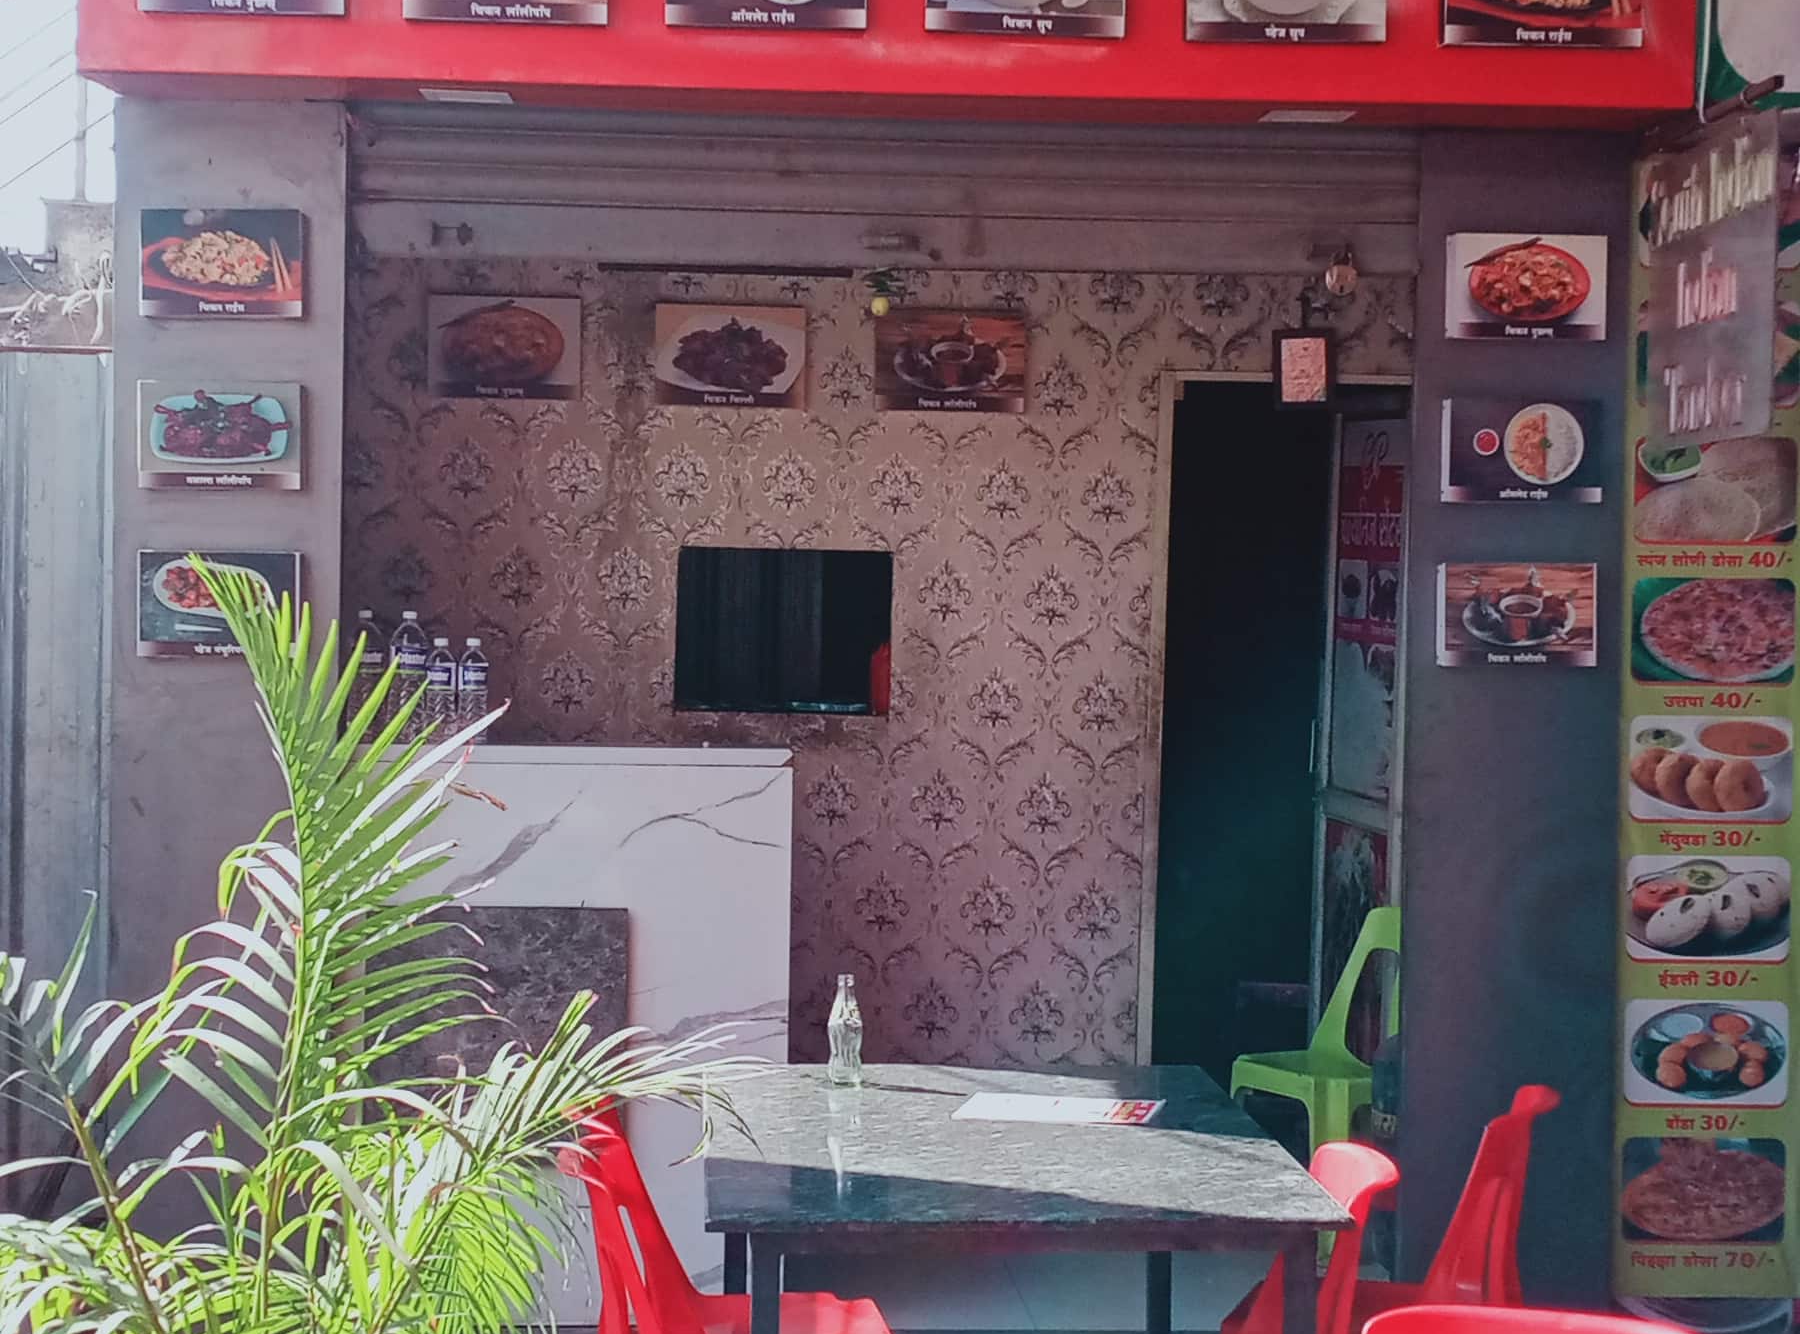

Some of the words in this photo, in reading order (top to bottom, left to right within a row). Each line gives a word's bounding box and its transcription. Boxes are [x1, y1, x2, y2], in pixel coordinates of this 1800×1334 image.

[470, 1, 501, 17] चिकन
[505, 3, 552, 18] लॉलीपॉप
[771, 8, 795, 25] राईस
[1002, 15, 1033, 30] चिकन
[1516, 26, 1545, 42] चिकन
[1548, 26, 1573, 44] राईस
[198, 300, 223, 313] चिकन
[1504, 323, 1529, 336] चिकन
[1711, 550, 1745, 568] डोसा
[1748, 550, 1793, 568] 40/-
[1710, 692, 1762, 709] 40/-
[1712, 830, 1761, 847] 30/-
[1705, 970, 1759, 987] 30/-
[1700, 1115, 1746, 1132] 30/-
[1724, 1251, 1776, 1269] 70/-
